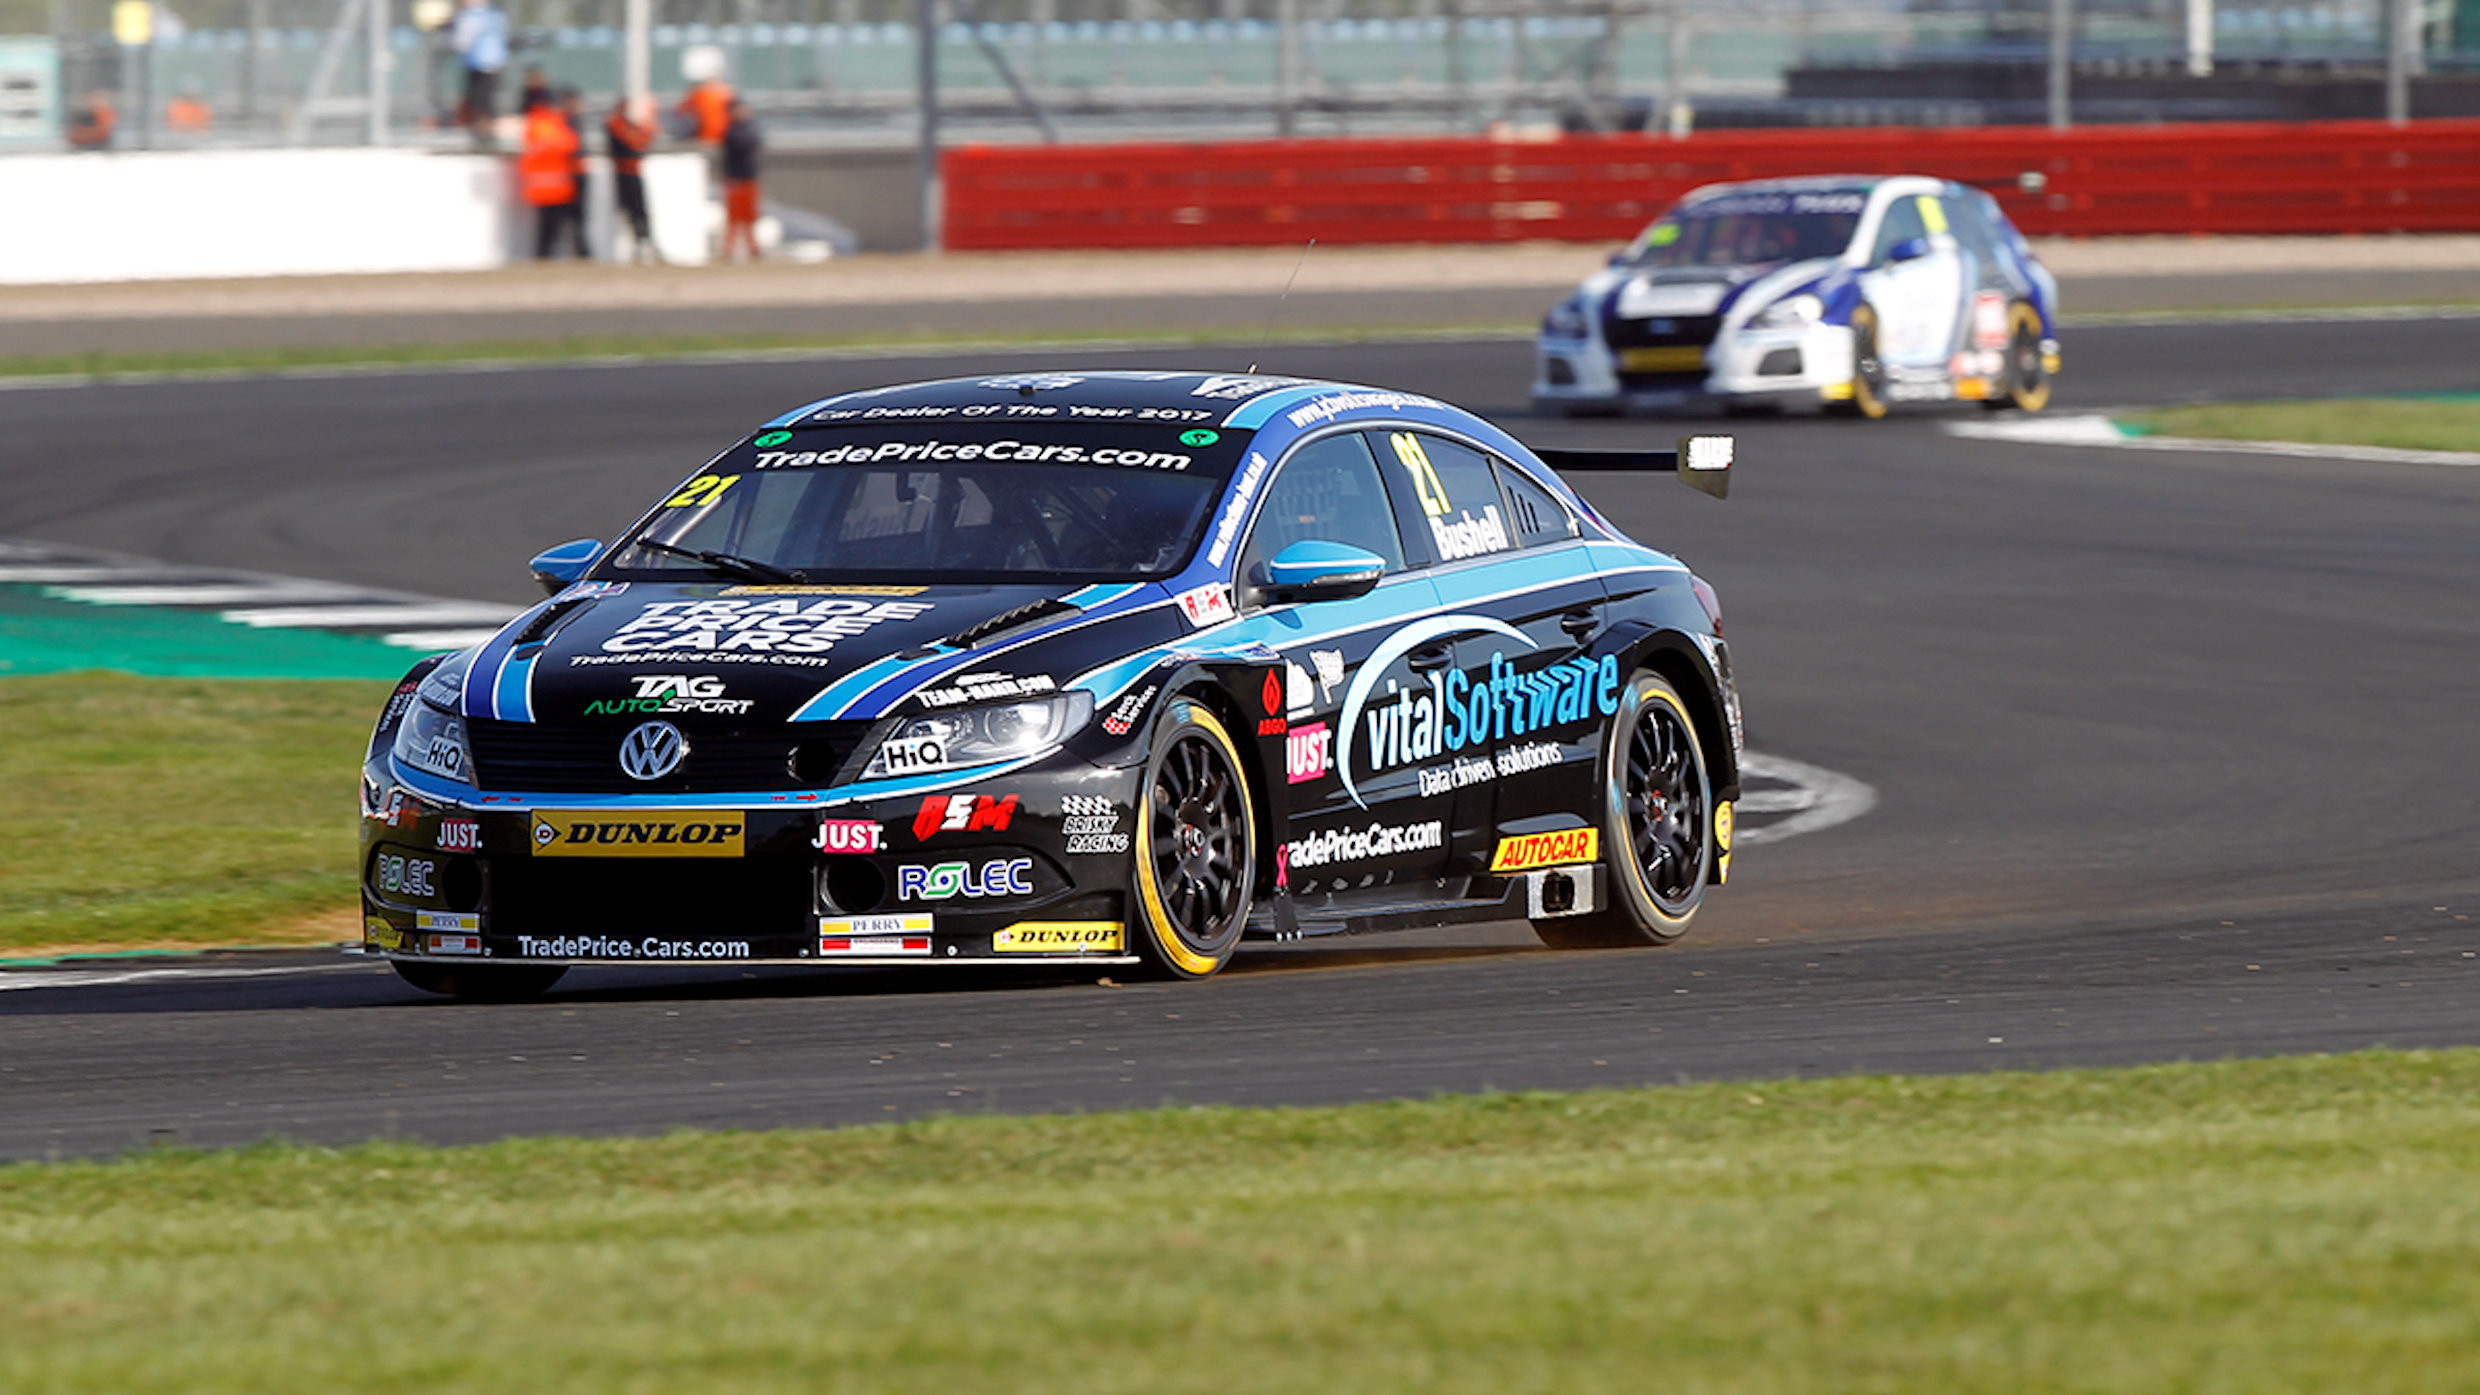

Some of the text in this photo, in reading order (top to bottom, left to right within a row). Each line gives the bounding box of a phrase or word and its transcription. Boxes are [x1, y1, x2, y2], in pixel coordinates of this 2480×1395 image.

[862, 405, 957, 418] Dealer
[961, 404, 1001, 417] Of
[1007, 404, 1058, 417] The
[1069, 405, 1133, 417] Year
[1137, 407, 1213, 421] 2017
[754, 440, 1192, 471] TradePriceCars.com
[1390, 431, 1452, 517] 21
[665, 474, 741, 507] 21
[1428, 504, 1509, 560] Bushell
[643, 599, 936, 621] TRADE
[616, 614, 886, 636] PRICE
[602, 631, 845, 652] CARS
[570, 651, 830, 668] TradePriceCars.com
[632, 675, 727, 698] TAG
[1367, 651, 1620, 771] vitalSoftware
[427, 740, 460, 771] HiQ
[886, 742, 945, 770] HiQ
[1418, 741, 1564, 798] Data driven solutions
[437, 822, 483, 849] JUST.
[564, 823, 743, 844] DUNLOP
[811, 823, 888, 850] JUST.
[1499, 830, 1588, 868] AUTOCAR
[899, 858, 1032, 901] ROLEC
[852, 918, 902, 931] PERRY
[1019, 929, 1119, 943] DUNLOP
